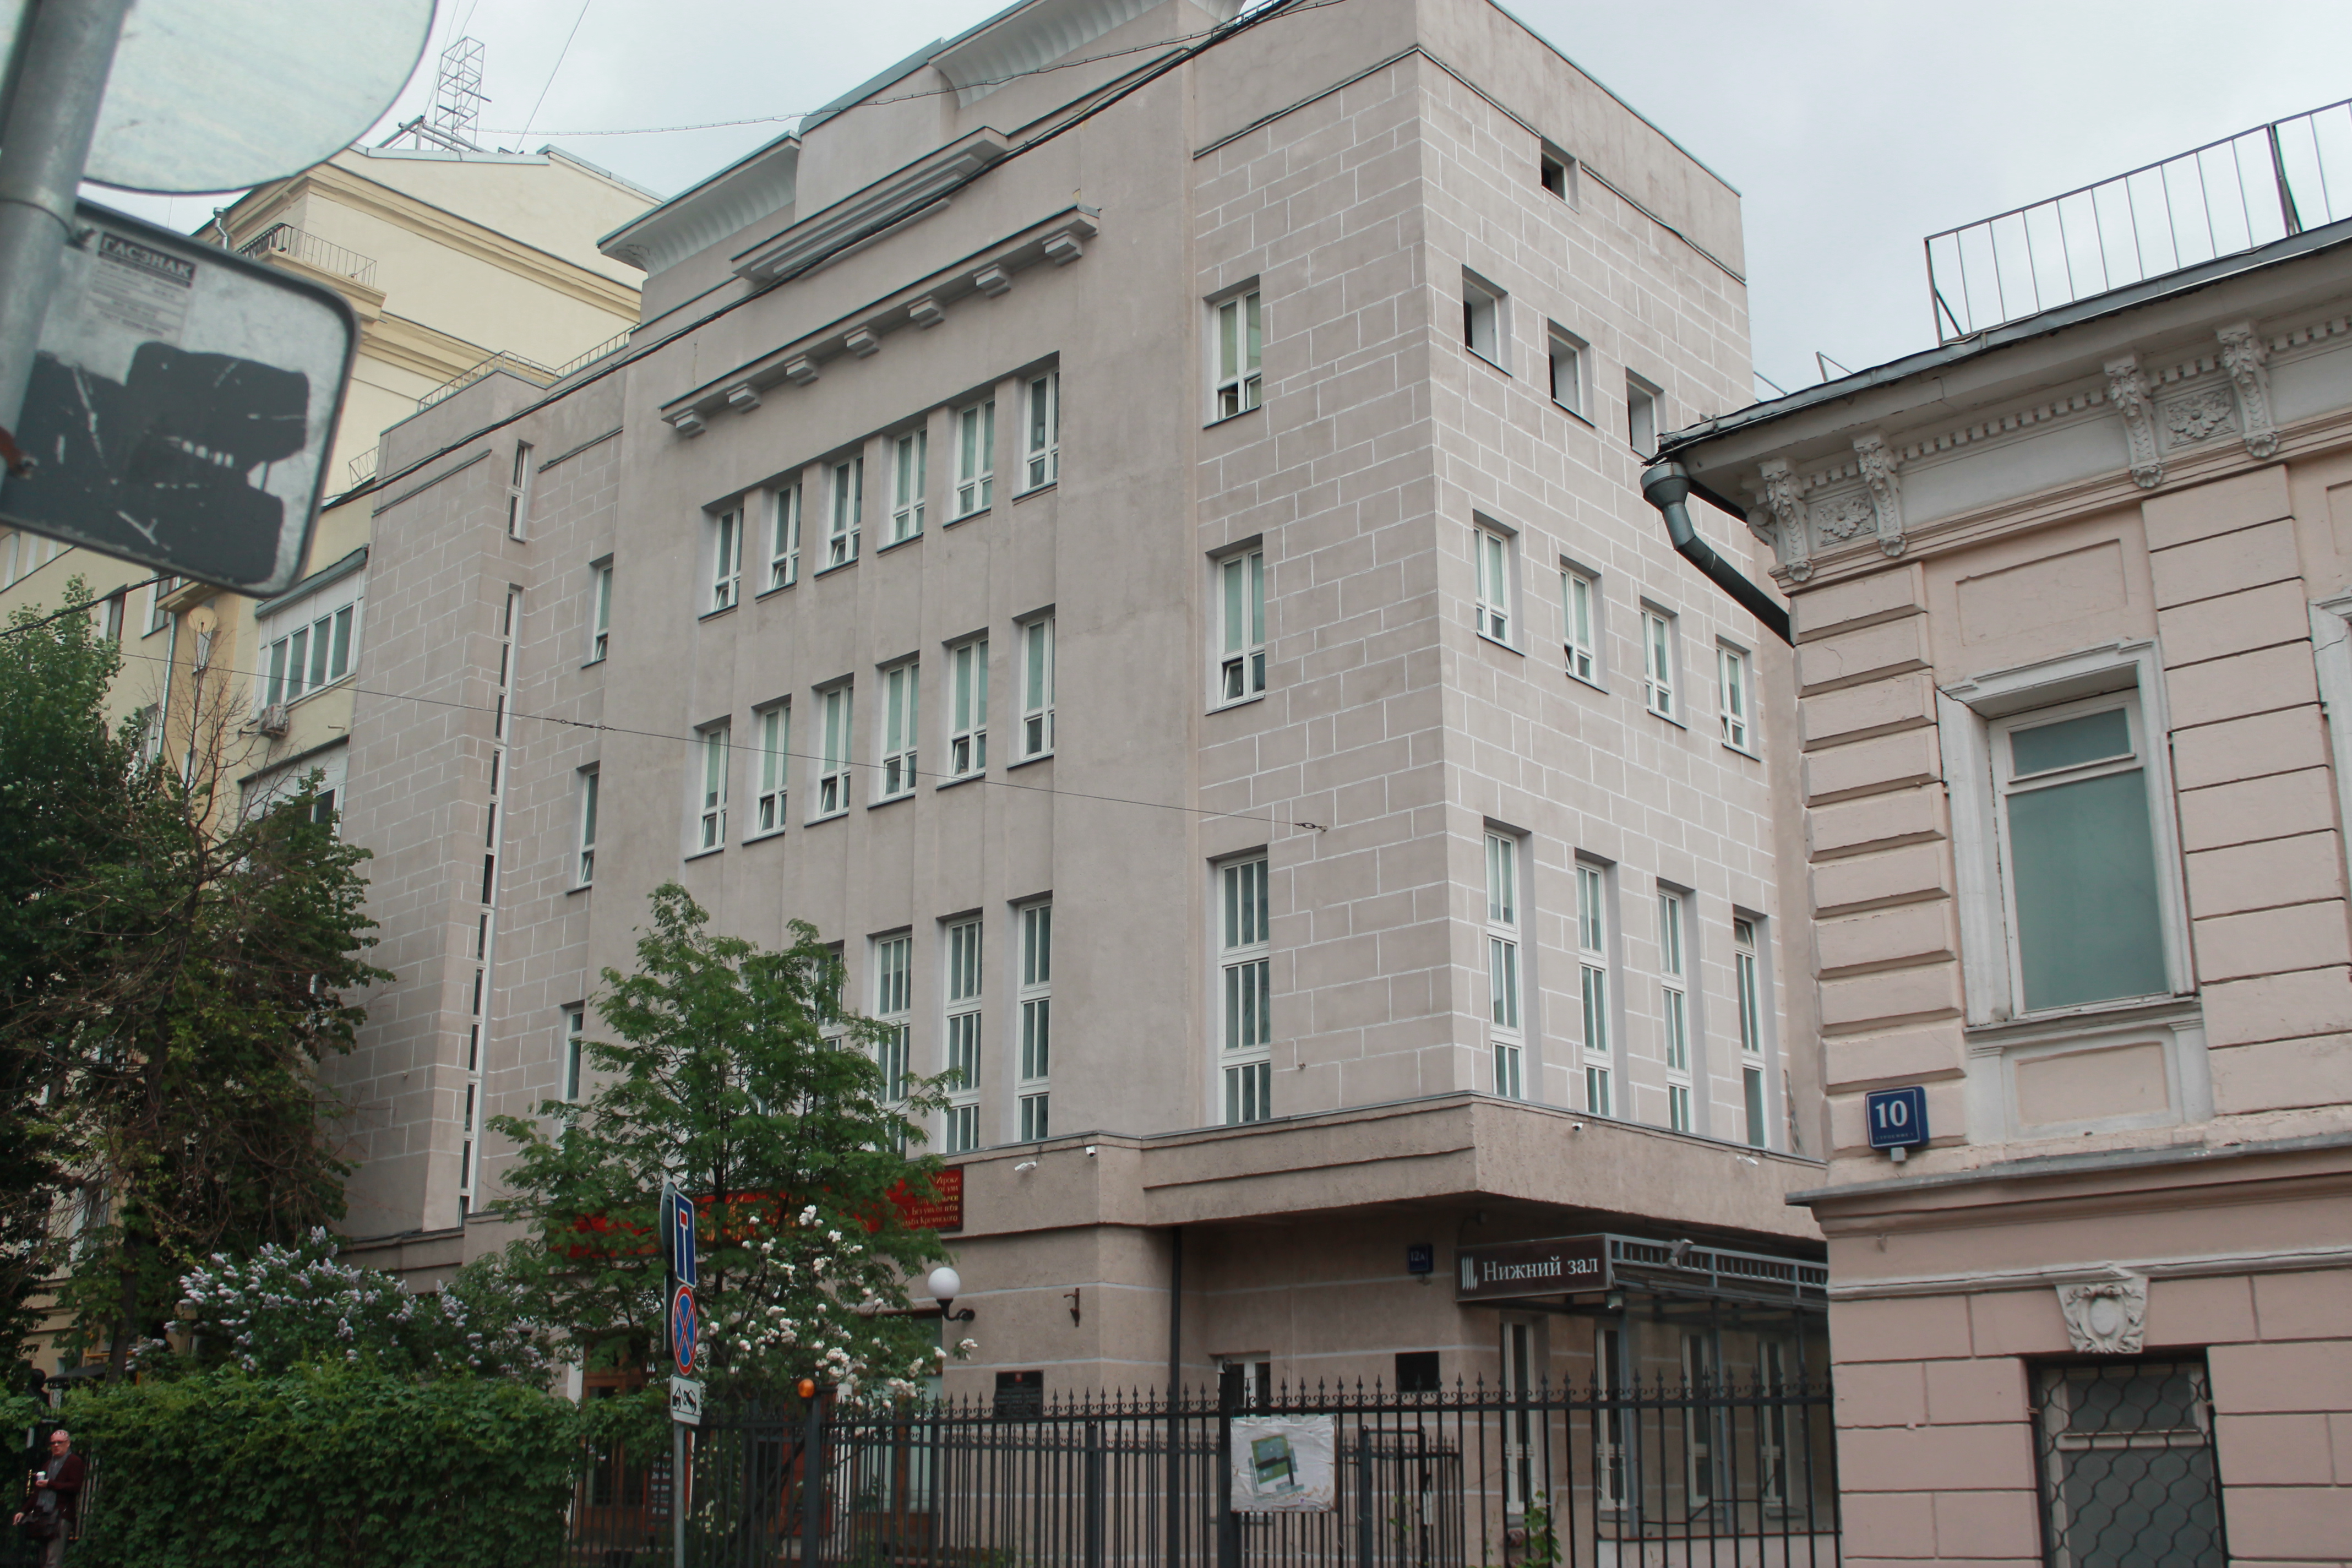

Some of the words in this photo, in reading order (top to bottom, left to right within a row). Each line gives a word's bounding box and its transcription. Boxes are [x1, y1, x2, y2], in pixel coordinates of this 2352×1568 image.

[102, 237, 192, 278] ГАСЗНАК
[1875, 1100, 1908, 1128] 10
[1483, 1256, 1561, 1282] Нижний
[1567, 1257, 1599, 1275] зал
